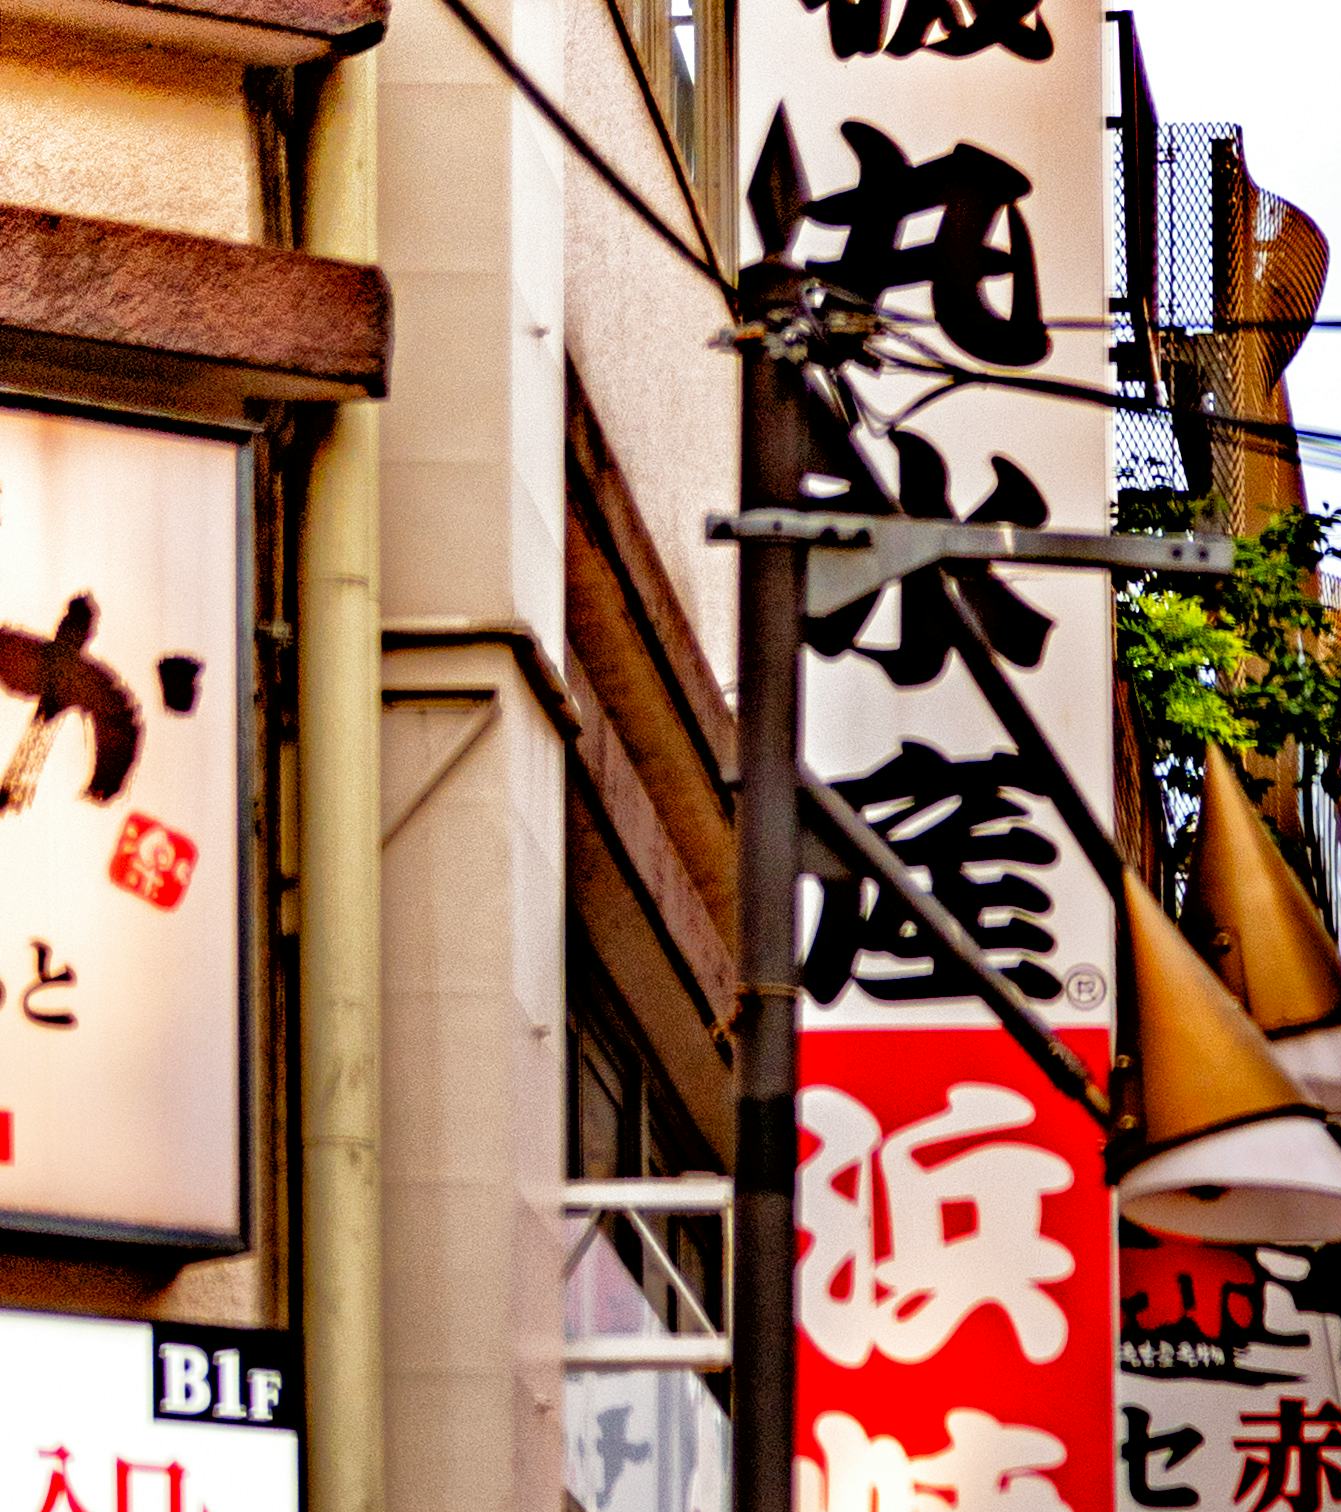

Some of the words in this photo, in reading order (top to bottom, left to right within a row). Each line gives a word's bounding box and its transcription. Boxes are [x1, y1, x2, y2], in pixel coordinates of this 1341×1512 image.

[802, 0, 1064, 1006] 丸水産
[160, 1344, 283, 1424] B1F
